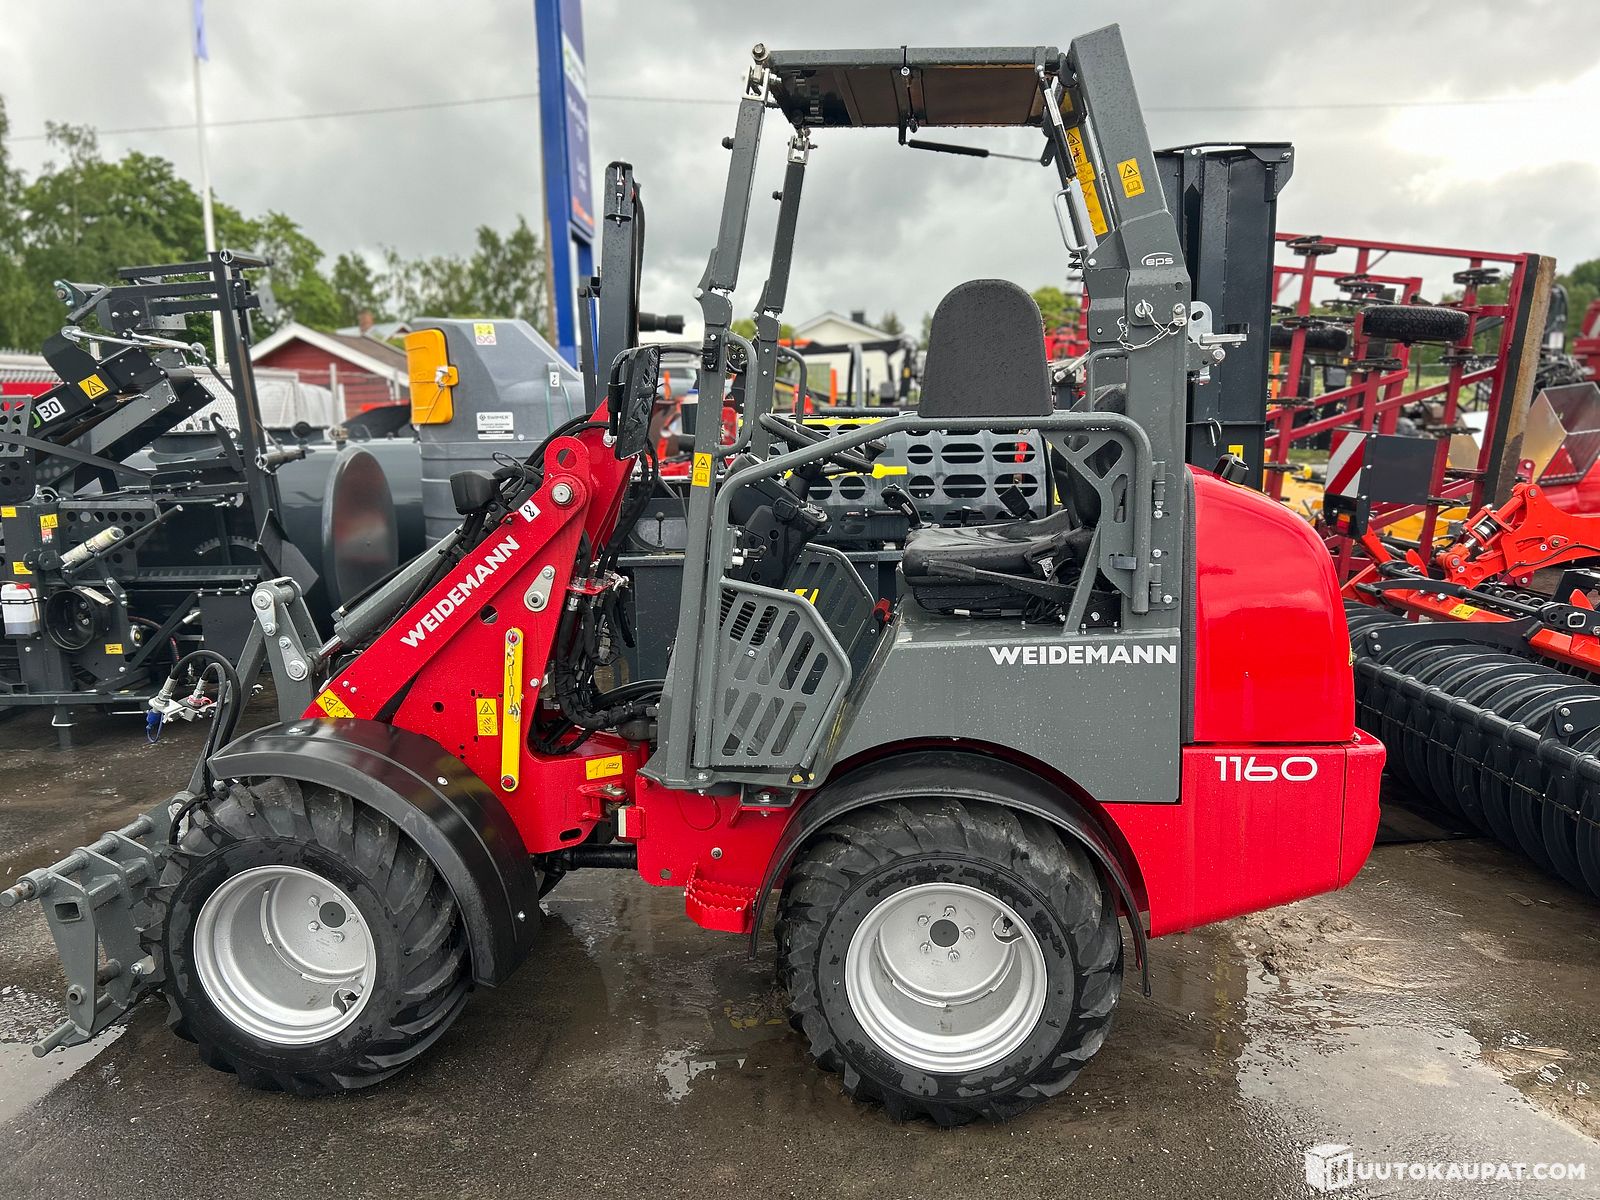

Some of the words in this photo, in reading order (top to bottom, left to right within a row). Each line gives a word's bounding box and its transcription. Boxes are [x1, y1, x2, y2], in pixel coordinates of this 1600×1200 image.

[1146, 257, 1174, 267] eps
[39, 401, 61, 419] 30
[400, 534, 521, 648] WEIDEMANN
[988, 645, 1177, 665] WEIDEMANN
[1214, 756, 1319, 782] 1160
